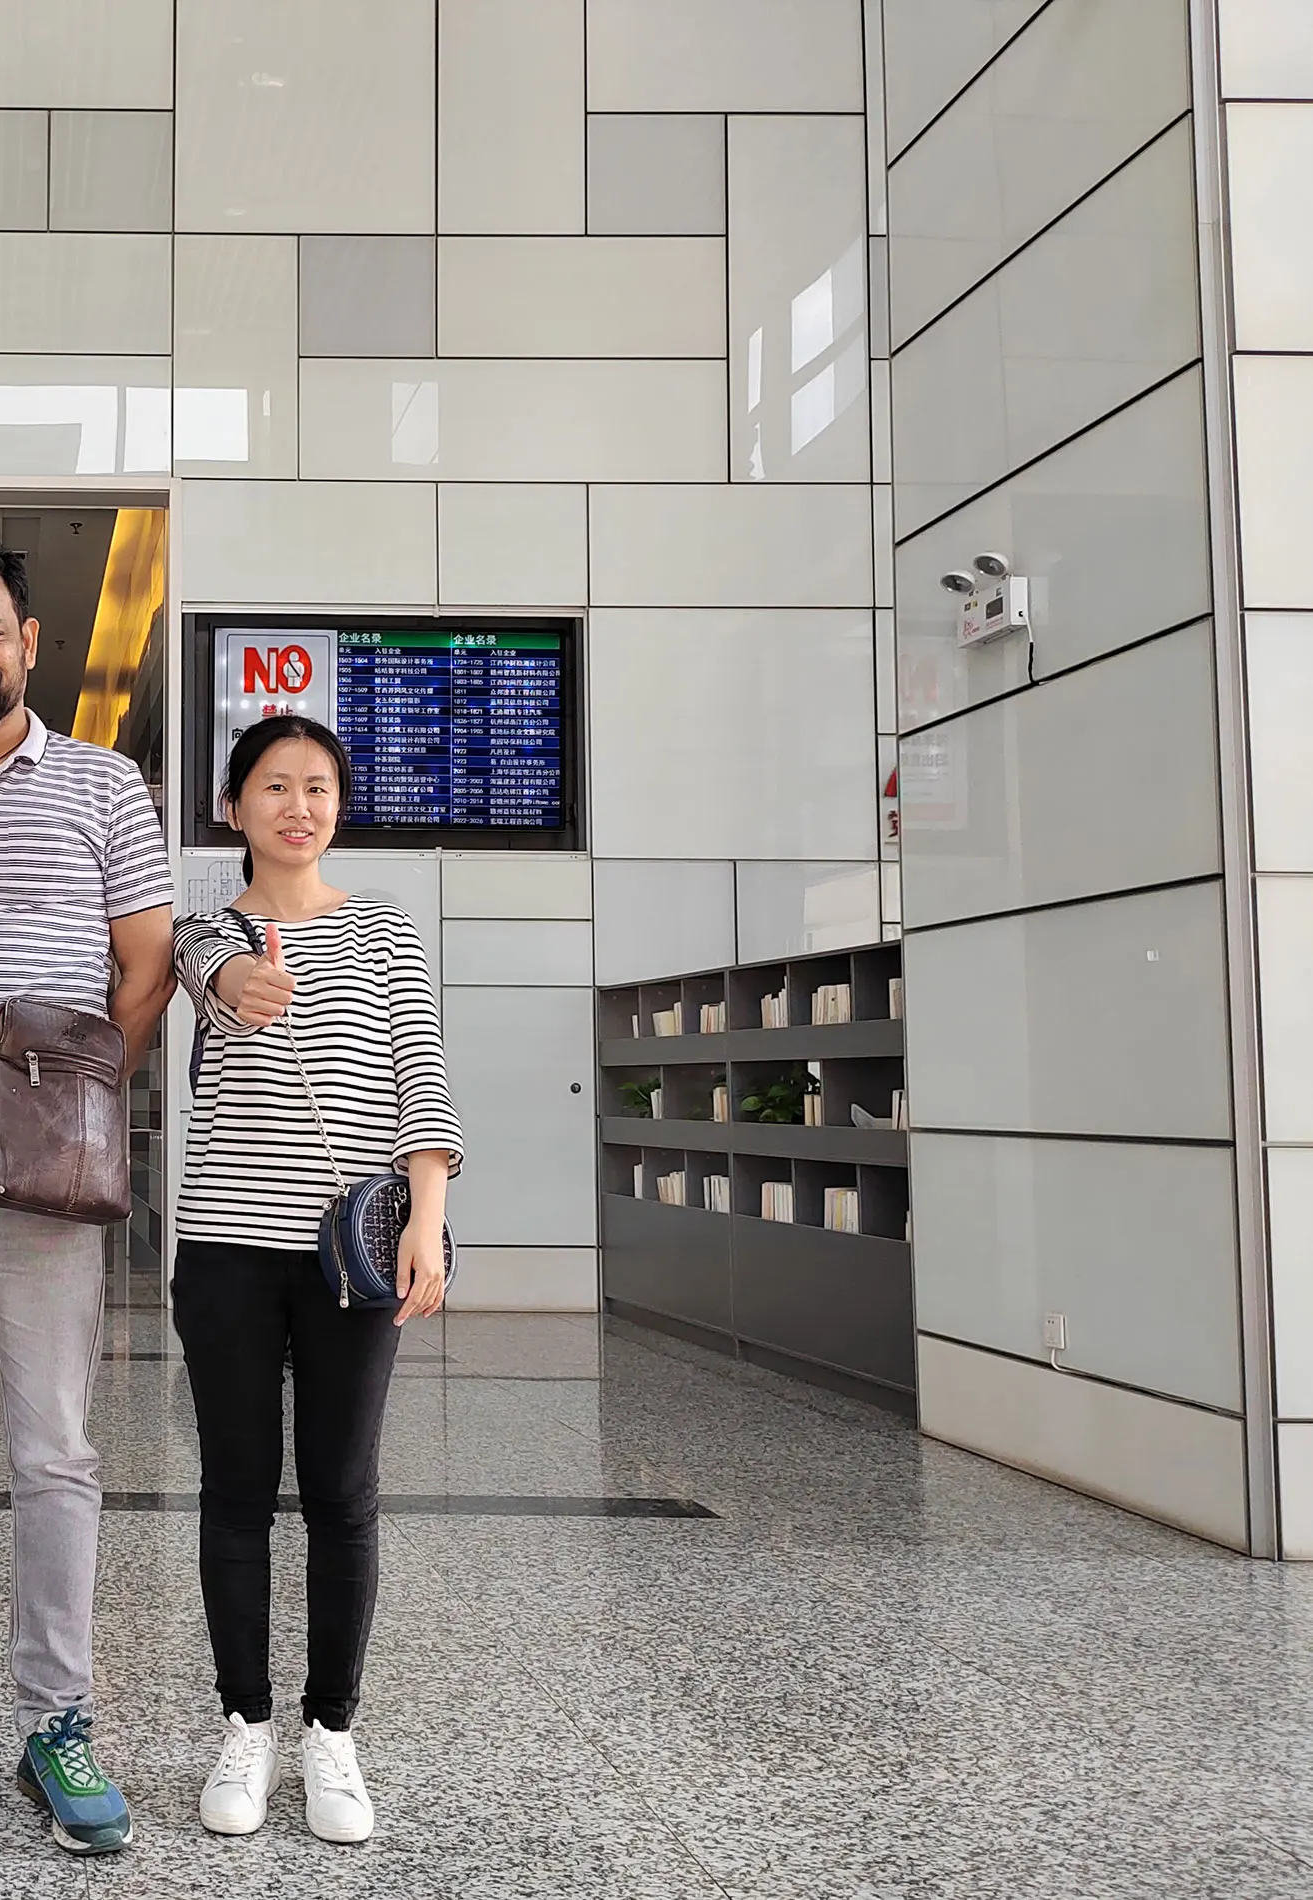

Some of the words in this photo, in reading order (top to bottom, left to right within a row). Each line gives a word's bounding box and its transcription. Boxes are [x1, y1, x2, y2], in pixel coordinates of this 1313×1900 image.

[339, 632, 382, 644] 企业名录
[453, 634, 497, 646] 企业名录
[453, 688, 467, 696] 1811
[338, 696, 352, 704] 1514
